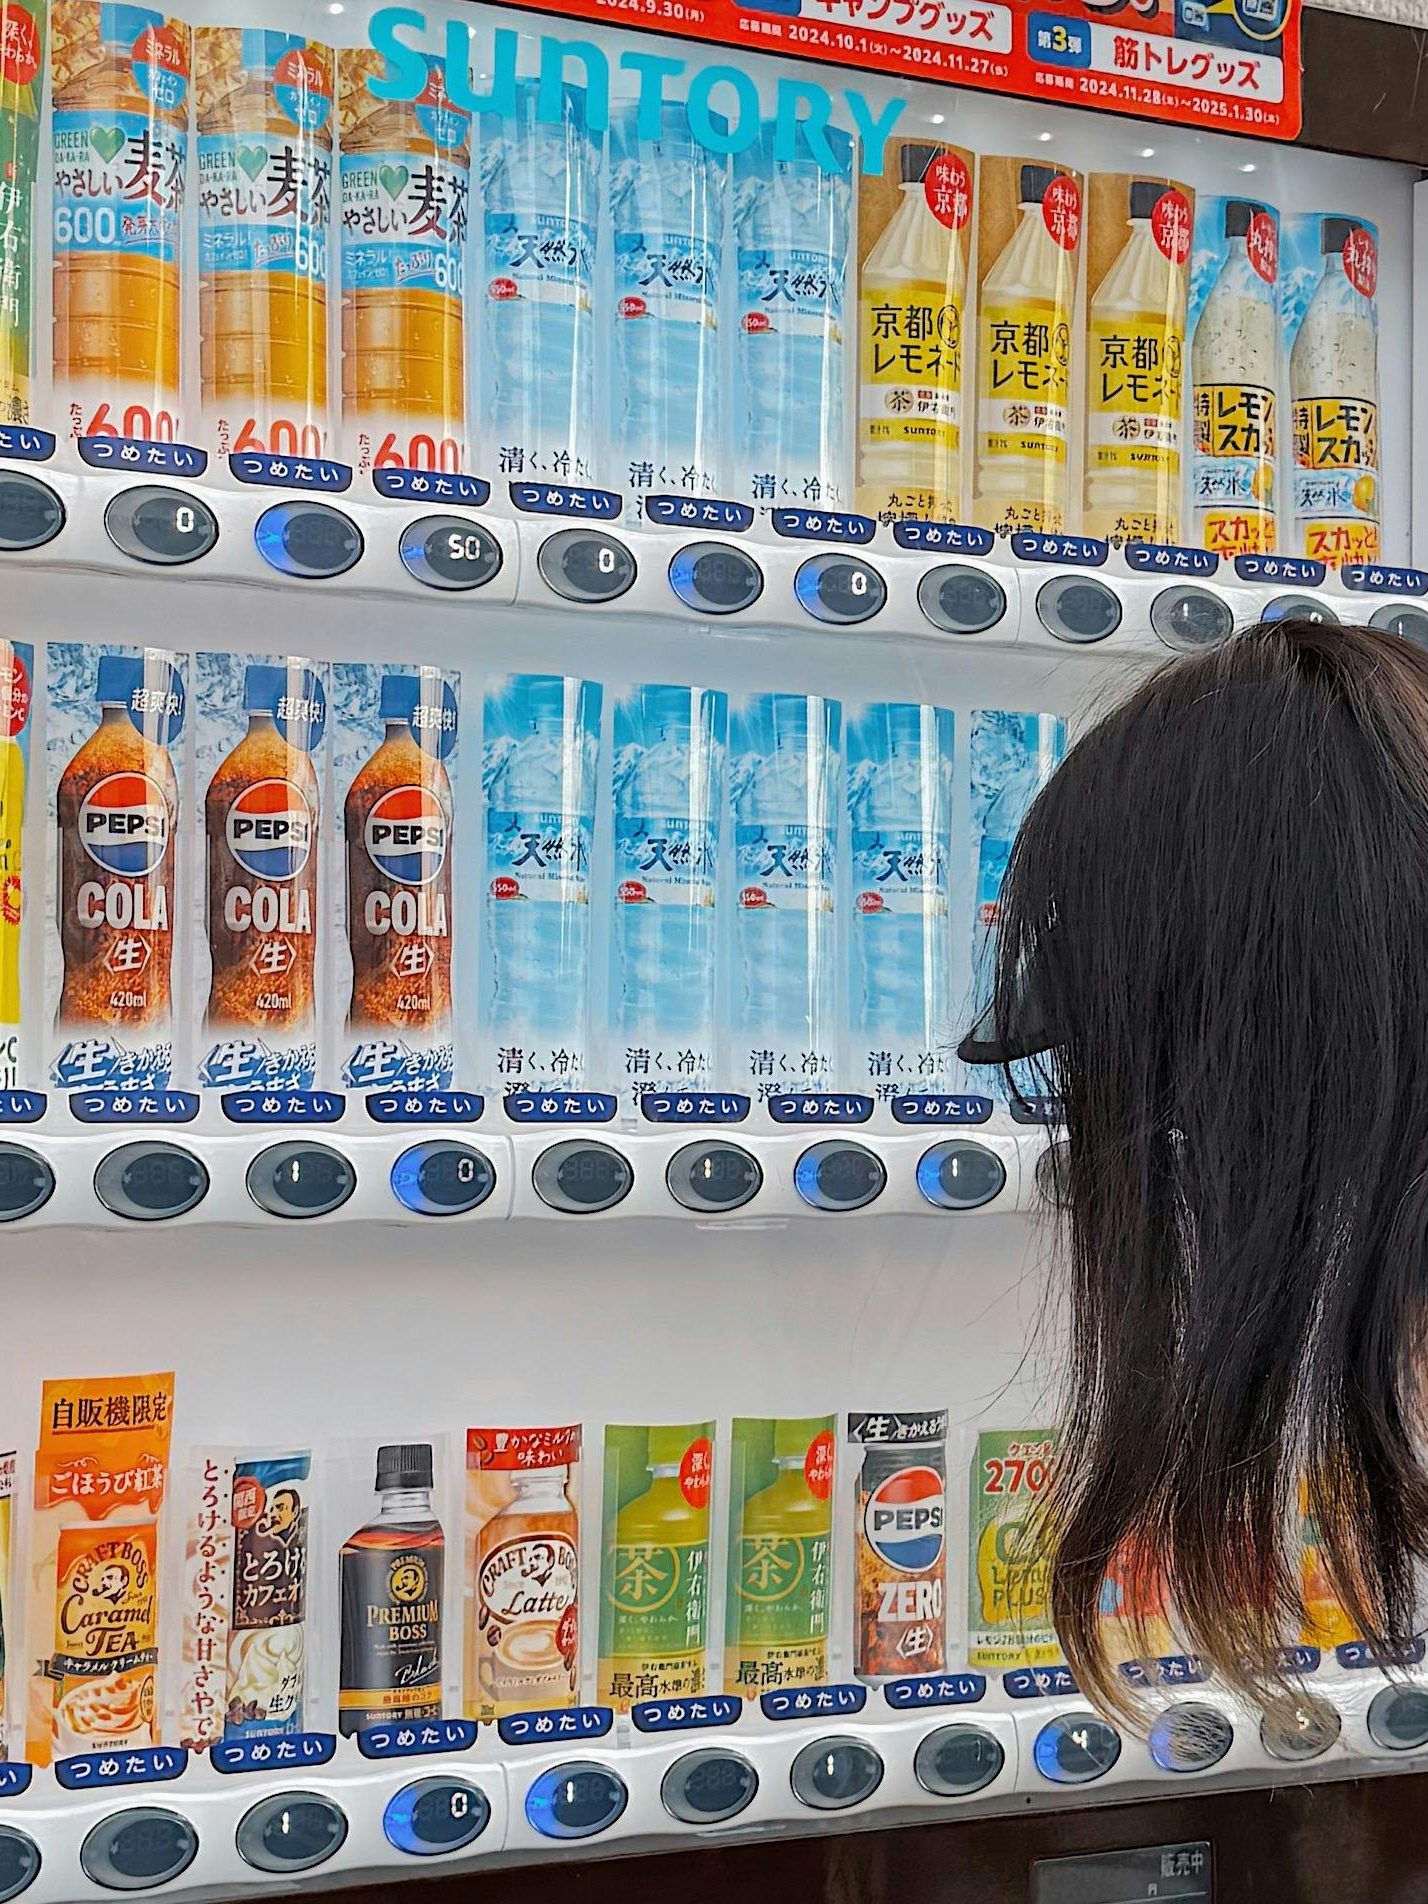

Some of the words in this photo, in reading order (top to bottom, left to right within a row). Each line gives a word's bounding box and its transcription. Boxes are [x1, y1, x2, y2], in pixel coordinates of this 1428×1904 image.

[1037, 26, 1082, 56] 第3弾
[1113, 36, 1260, 91] 筋トレグッズ
[368, 6, 907, 177] SUNTORY
[872, 304, 933, 338] 京都
[92, 444, 194, 469] つめたい
[522, 485, 611, 513] つめたい
[904, 526, 991, 549] つめたい
[131, 686, 183, 718] 超爽快!
[86, 812, 167, 839] PEPSI
[76, 883, 168, 934] COLA
[110, 940, 143, 973] 生
[52, 1391, 169, 1431] 自販機限定
[50, 1460, 165, 1496] ごほうび紅茶
[61, 1594, 152, 1637] Caramel
[367, 1602, 440, 1628] PREMIUM
[501, 1588, 567, 1618] Latte
[876, 1579, 942, 1620] ZERO
[85, 1626, 140, 1657] TEA
[388, 1623, 428, 1642] BOSS
